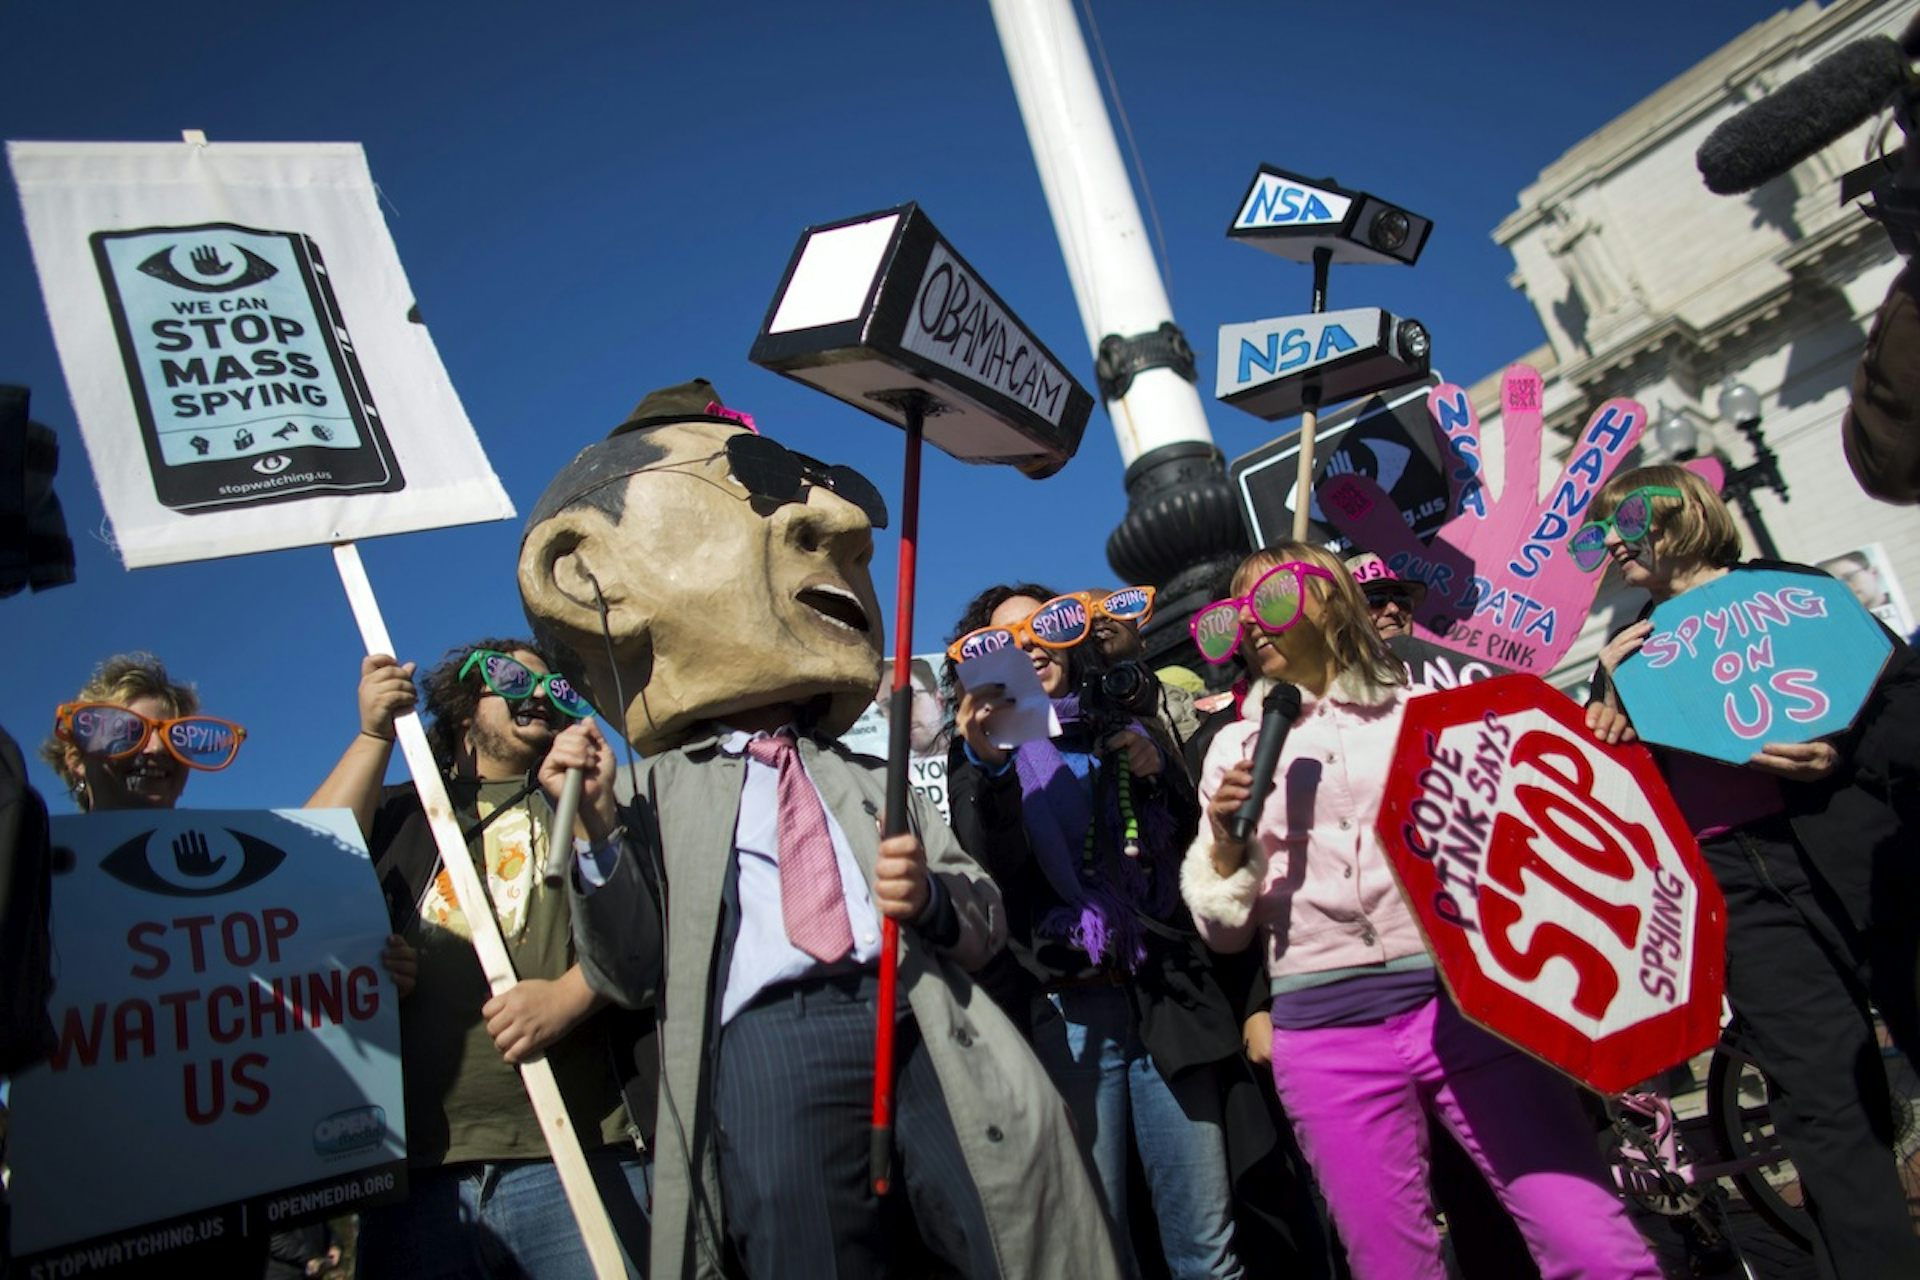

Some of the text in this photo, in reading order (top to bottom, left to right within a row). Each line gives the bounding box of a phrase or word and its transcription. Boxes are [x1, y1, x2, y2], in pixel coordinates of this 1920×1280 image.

[1245, 180, 1332, 225] NSA
[152, 313, 305, 352] STOP
[171, 297, 269, 314] WE CAN
[160, 349, 320, 388] MASS
[919, 261, 1064, 417] OBAMA-CAM
[1237, 323, 1359, 384] NSA
[171, 382, 328, 418] SPYING
[218, 471, 332, 495] stopwatching.us
[1437, 391, 1634, 579] NSA HANDS
[1032, 603, 1087, 637] SPYING
[1103, 590, 1148, 612] SPYING
[1199, 607, 1233, 643] STOP
[1387, 551, 1558, 645] OUR DATA
[1640, 587, 1828, 668] SPYING
[1428, 614, 1538, 668] CODE PINK
[1712, 634, 1775, 685] ON
[78, 711, 141, 741] STOP
[1724, 668, 1830, 739] US
[1404, 733, 1464, 861] CODE
[1434, 709, 1513, 933] PINK SAYS
[1478, 729, 1659, 1022] STOP
[126, 907, 299, 980] STOP
[1640, 865, 1685, 1005] SPYING
[49, 965, 380, 1072] WATCHING
[183, 1052, 271, 1126] US
[29, 1172, 395, 1280] STOPWATCHING.US OPENMEDIA.ORG
